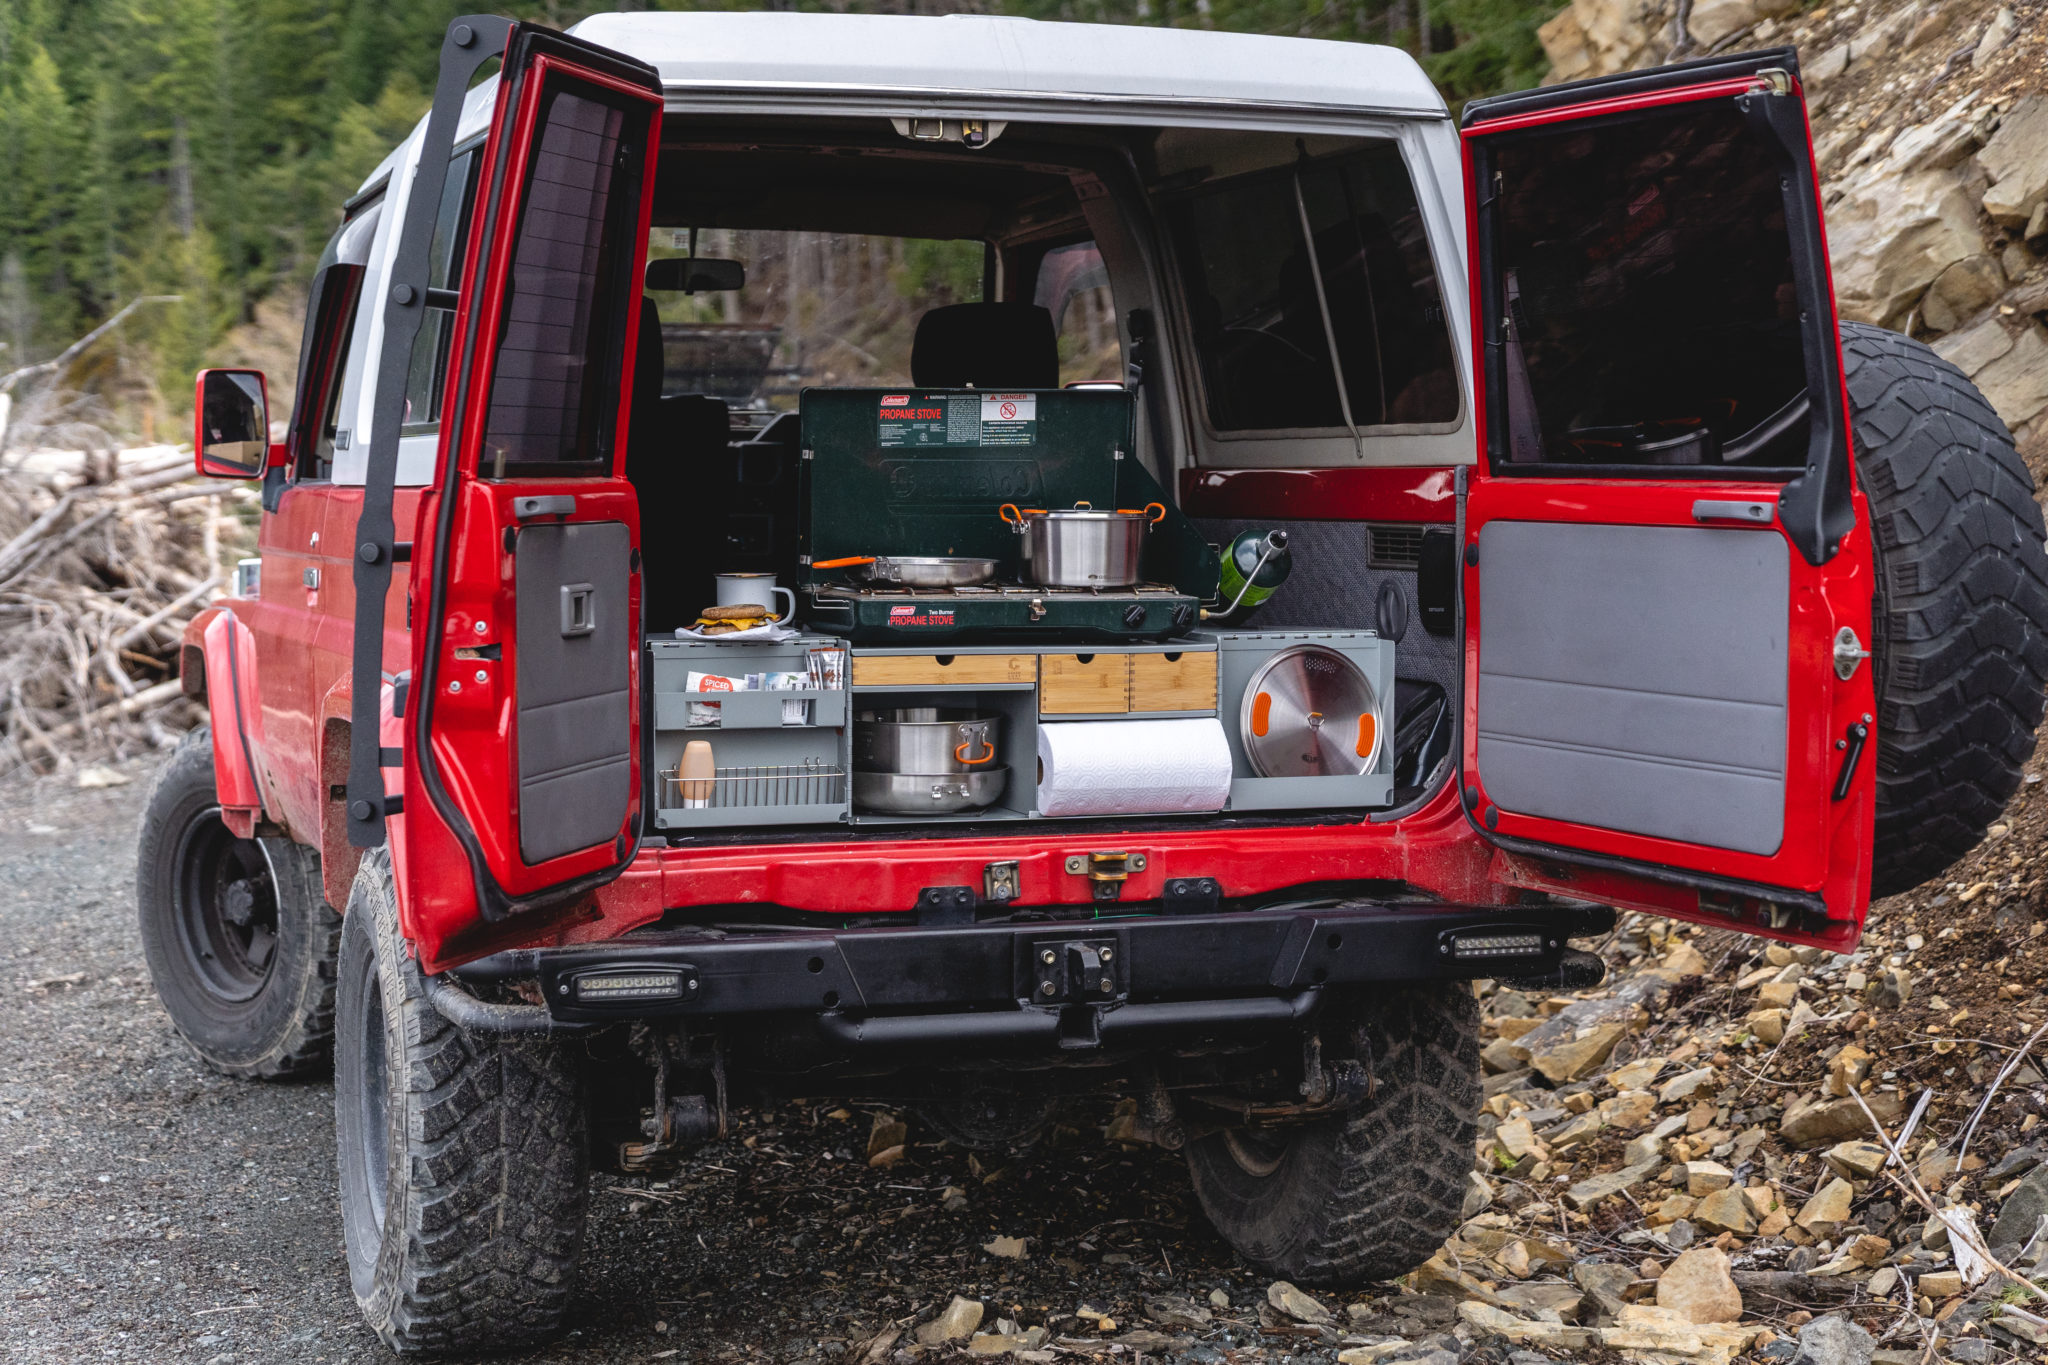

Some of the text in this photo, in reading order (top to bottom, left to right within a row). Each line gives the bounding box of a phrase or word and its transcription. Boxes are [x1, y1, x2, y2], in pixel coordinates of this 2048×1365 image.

[880, 408, 942, 420] PROPANE STOVE
[890, 615, 954, 625] PROPANE STOVE
[705, 679, 730, 690] SPICED
